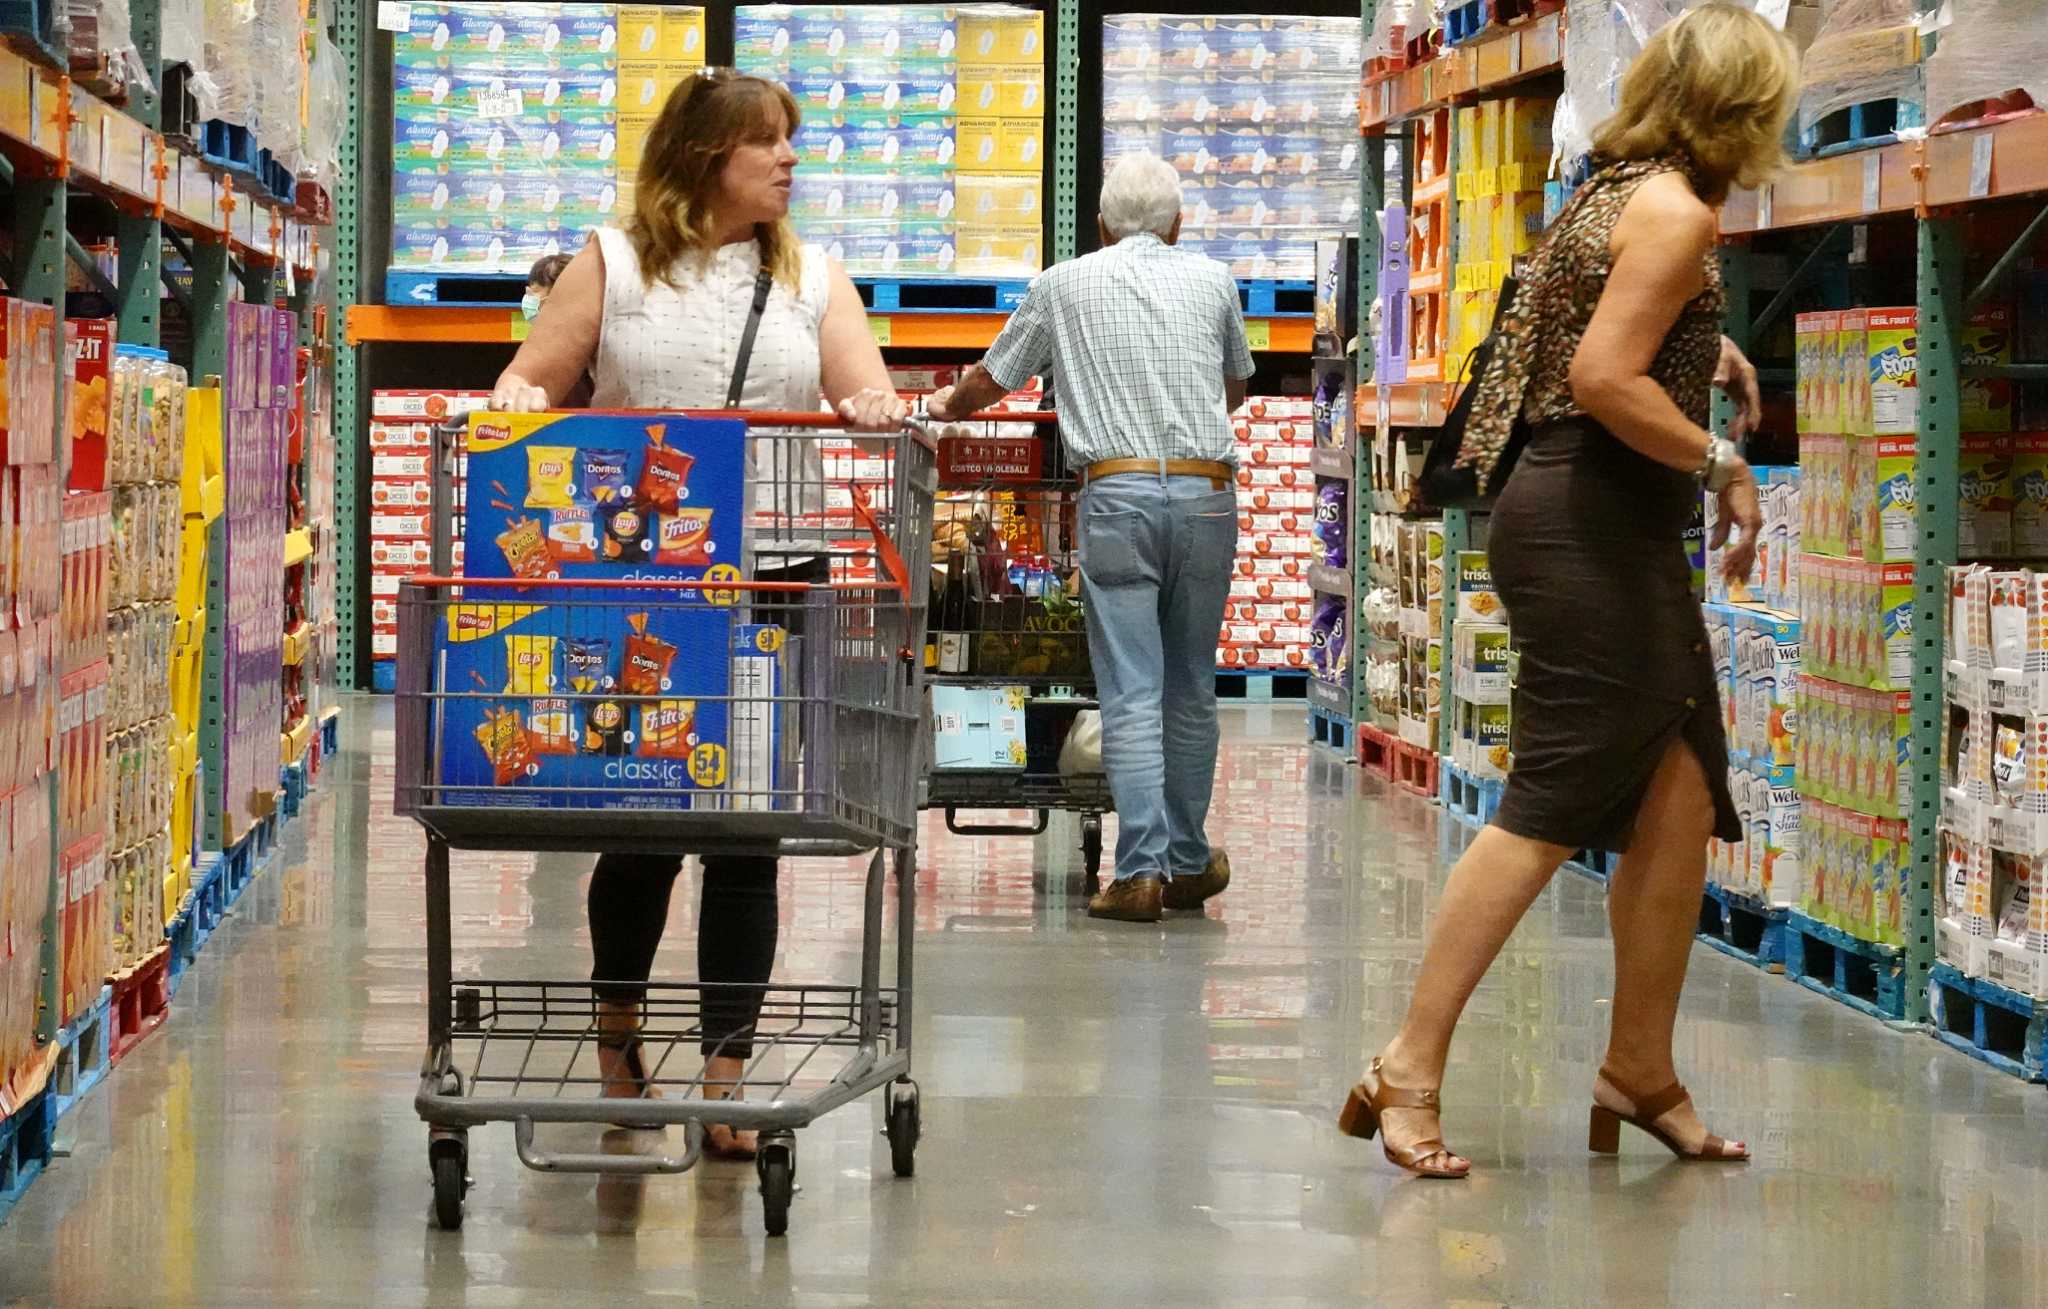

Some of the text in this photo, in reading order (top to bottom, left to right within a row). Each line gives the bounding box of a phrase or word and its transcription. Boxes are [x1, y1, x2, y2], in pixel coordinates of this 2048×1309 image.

[587, 463, 621, 474] Doritos
[650, 464, 681, 481] Doritos
[950, 464, 980, 473] COSTCO
[665, 518, 703, 539] Fritos
[680, 591, 696, 599] MIX
[604, 758, 682, 780] classic
